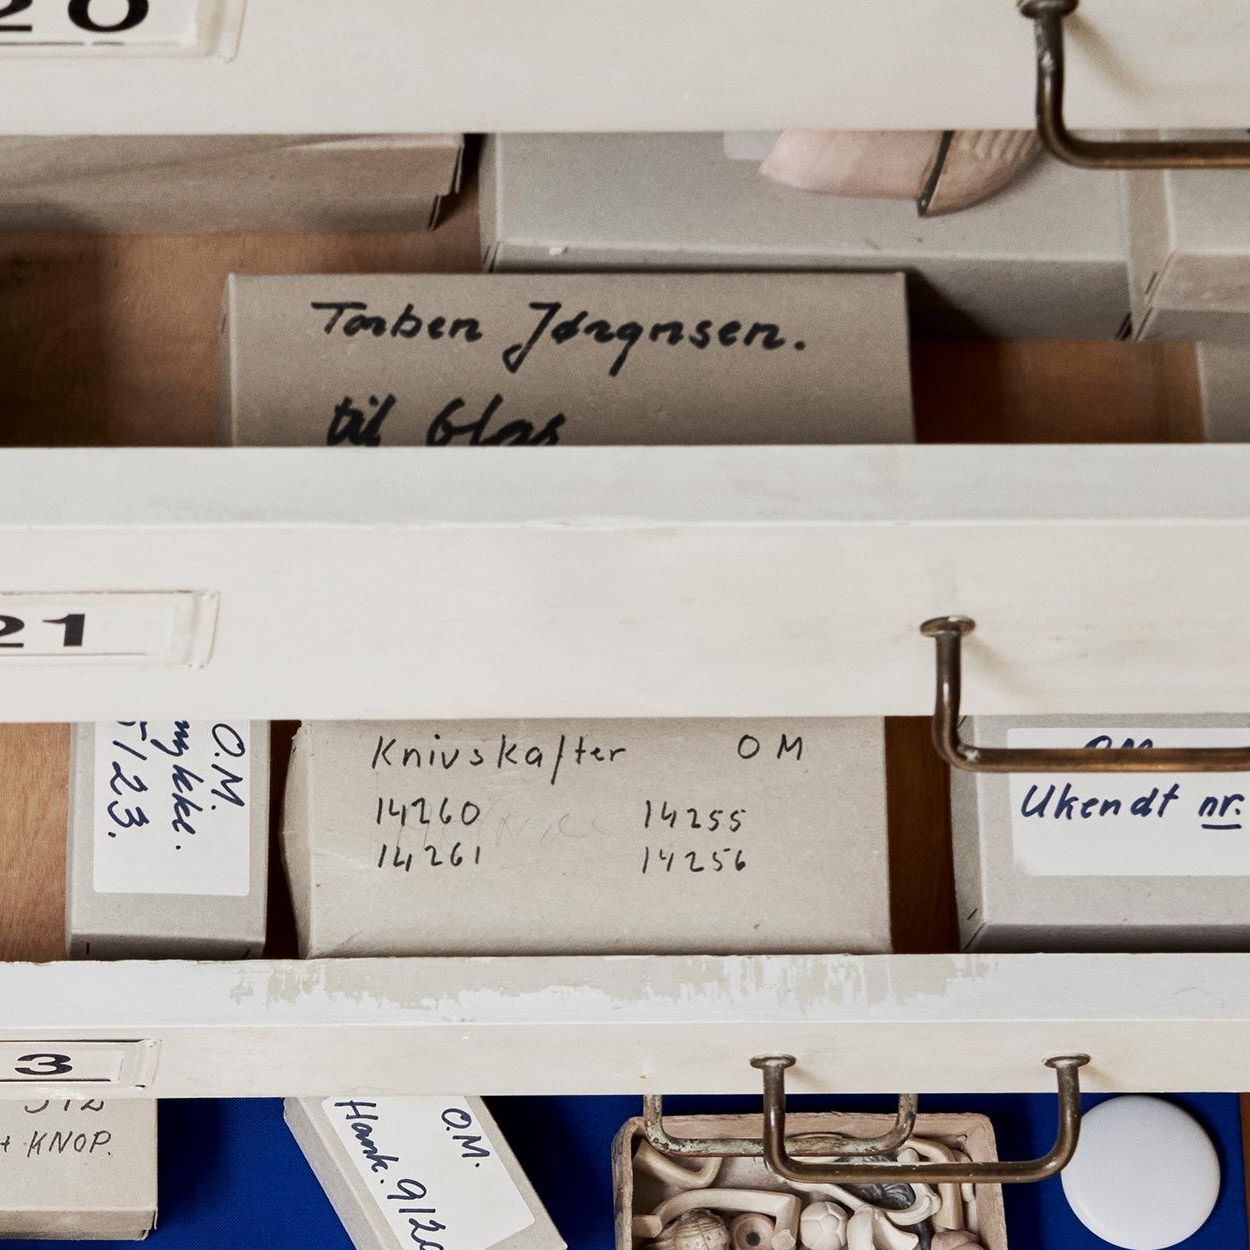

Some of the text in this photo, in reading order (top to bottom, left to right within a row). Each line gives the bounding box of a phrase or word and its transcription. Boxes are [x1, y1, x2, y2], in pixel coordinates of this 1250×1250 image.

[376, 797, 481, 826] 14260
[645, 800, 748, 832] 14255
[1021, 782, 1180, 820] Ukendt
[378, 842, 748, 874] 14261 14256
[441, 1108, 490, 1168] O.M.
